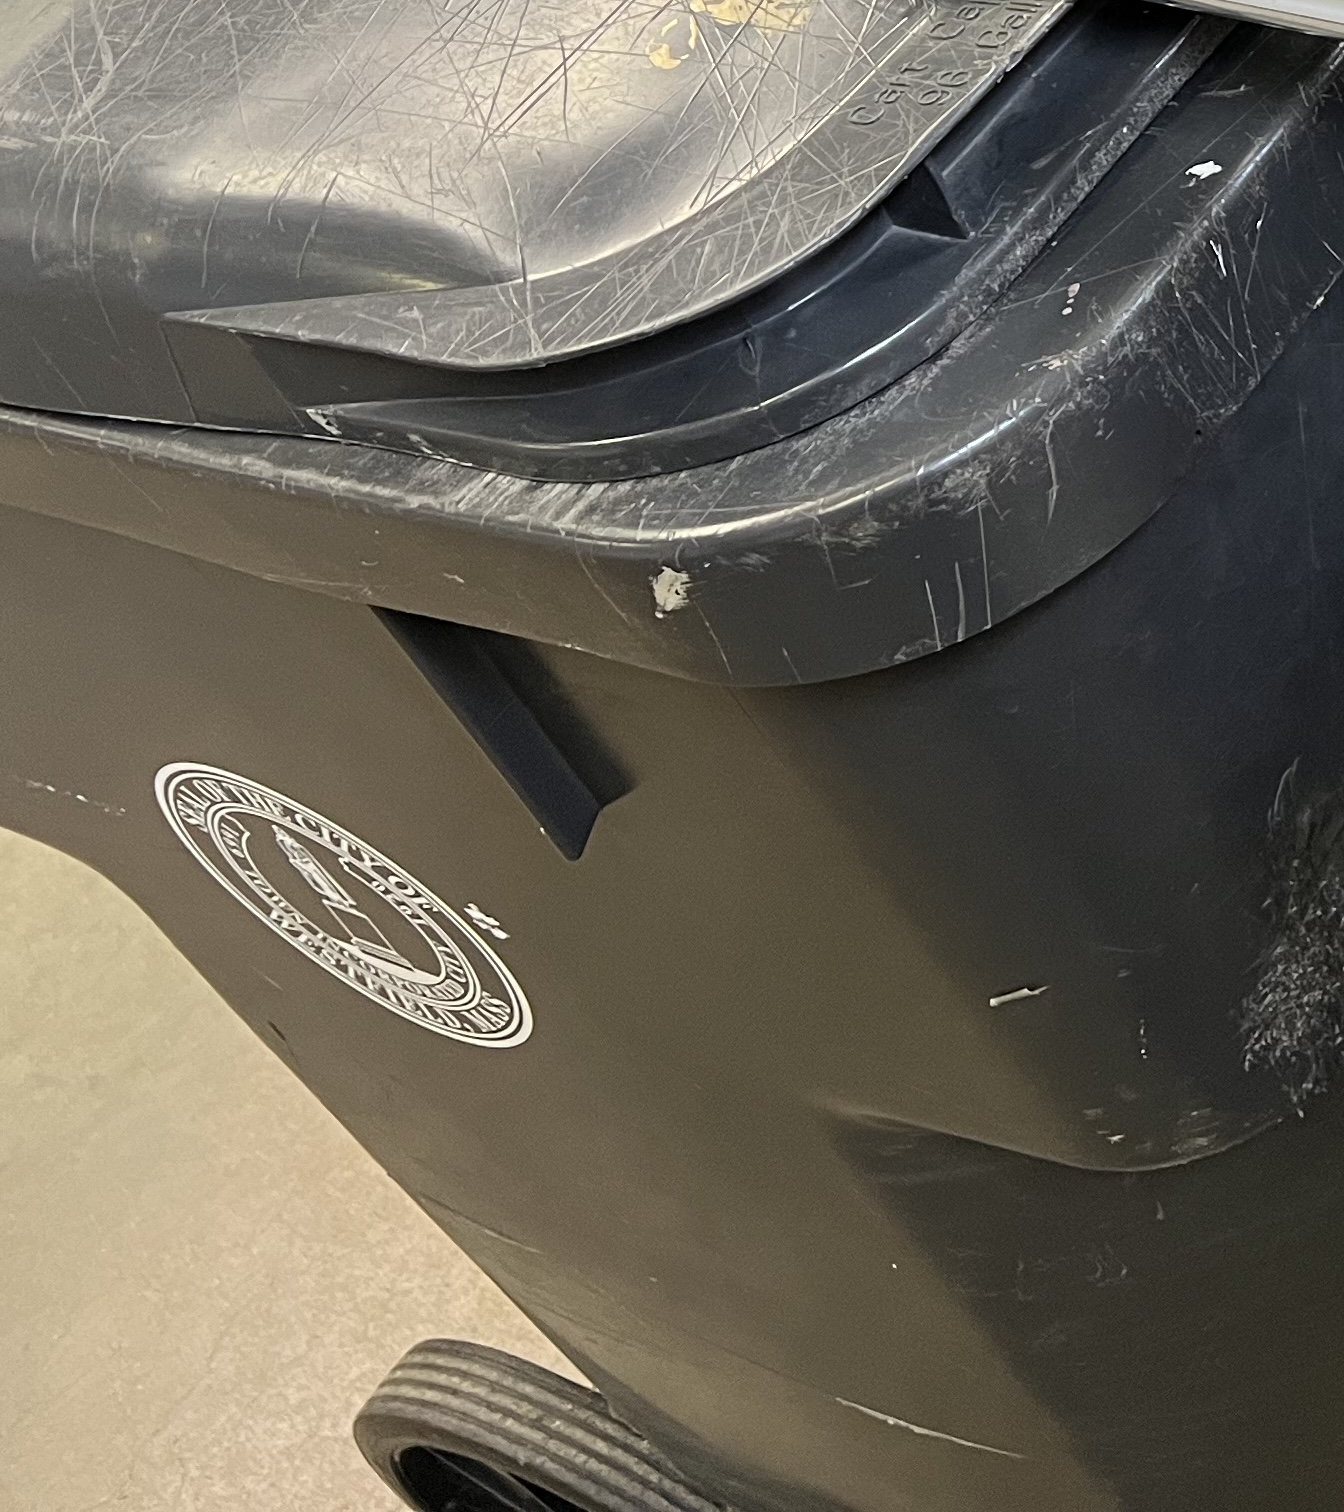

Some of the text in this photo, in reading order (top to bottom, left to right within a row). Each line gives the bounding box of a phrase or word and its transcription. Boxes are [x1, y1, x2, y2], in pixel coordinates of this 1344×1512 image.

[848, 60, 930, 126] Cart
[916, 70, 973, 107] 96
[221, 783, 293, 823] THE
[295, 812, 379, 867] CITY
[388, 875, 440, 914] OF
